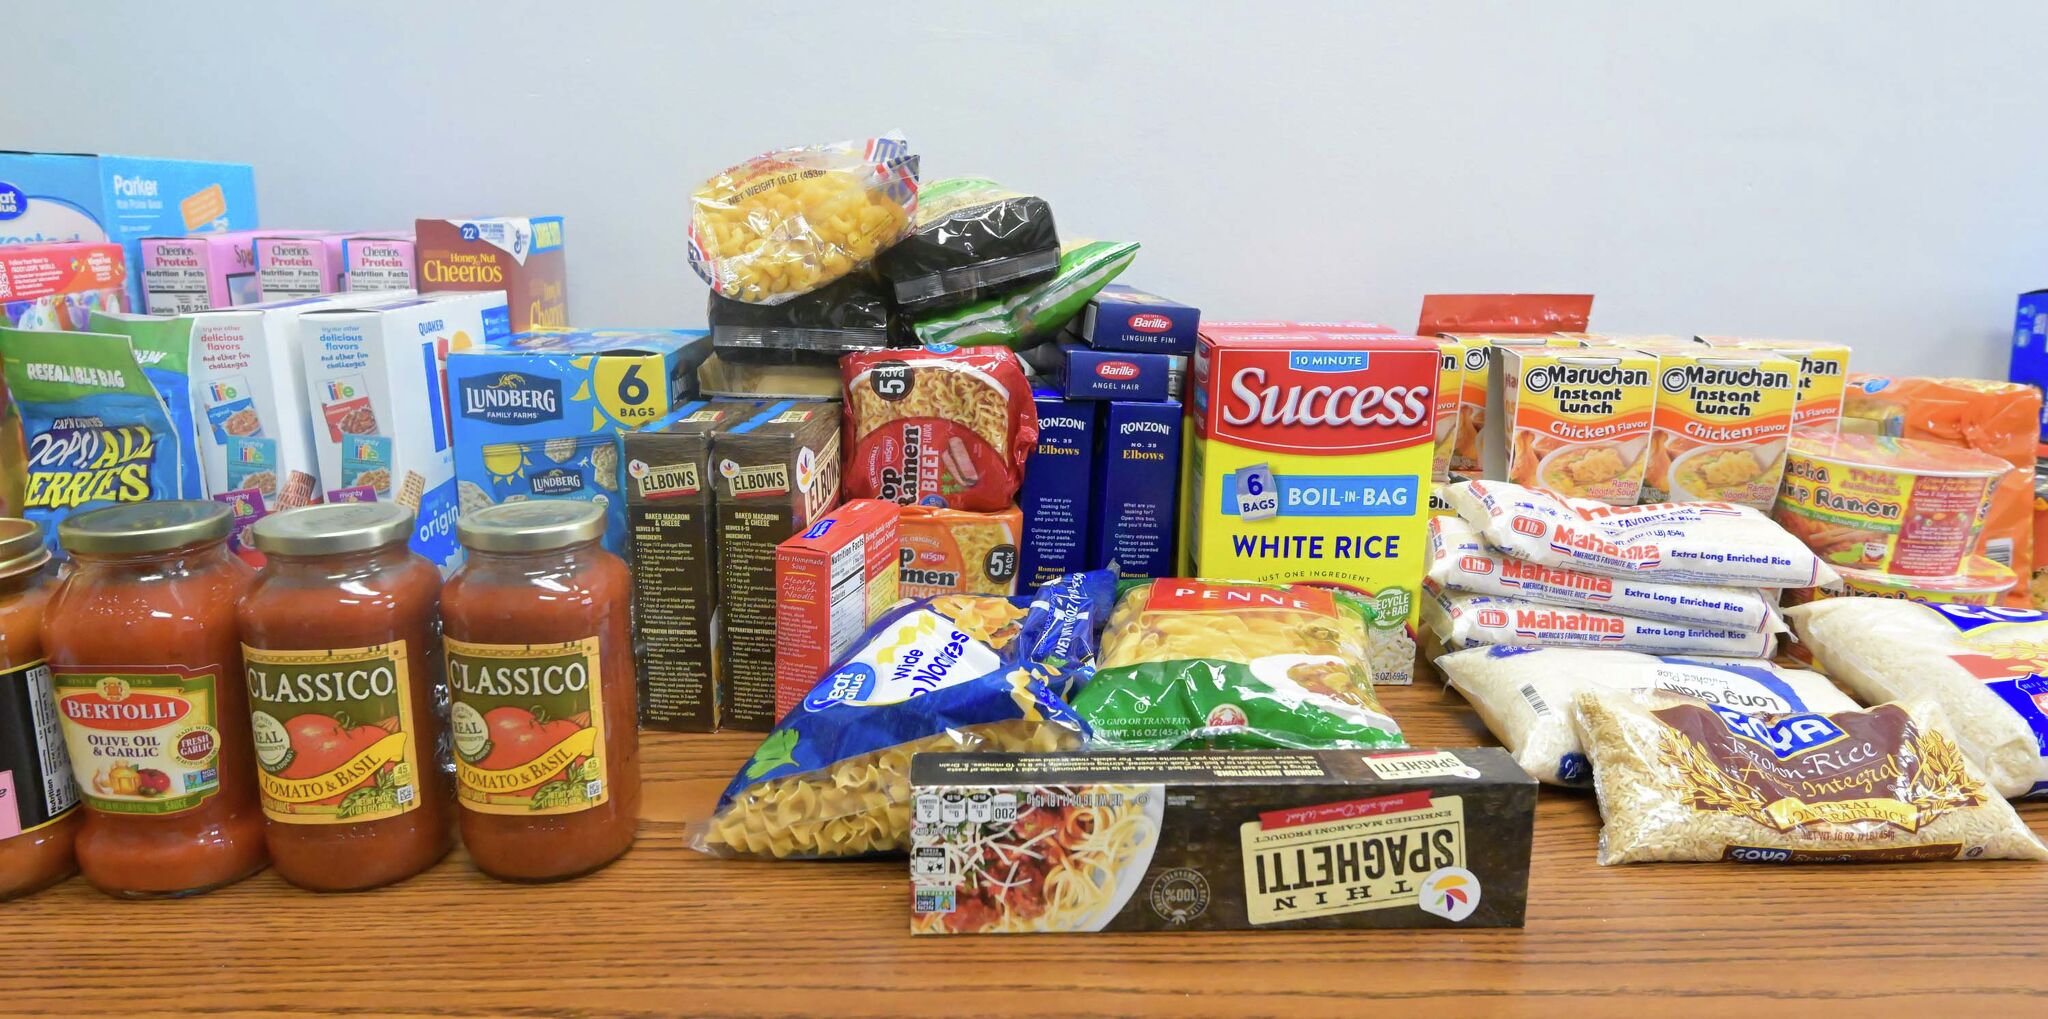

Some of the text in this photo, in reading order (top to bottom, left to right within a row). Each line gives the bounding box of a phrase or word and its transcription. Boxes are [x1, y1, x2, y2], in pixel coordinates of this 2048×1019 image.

[113, 175, 157, 196] Parker
[728, 193, 744, 205] NET
[746, 179, 775, 197] WEIGHT
[777, 176, 787, 187] 16
[788, 173, 798, 184] OZ
[462, 227, 475, 239] 22
[156, 245, 194, 256] Cheerios
[272, 245, 310, 257] Cheerios
[362, 246, 399, 257] Cheerios
[156, 257, 198, 267] Protein
[271, 257, 313, 267] Protein
[361, 258, 403, 267] Protein
[450, 253, 496, 265] Honey Nut
[261, 269, 294, 277] Nutrition
[423, 260, 504, 283] Cheerios
[418, 319, 444, 336] QUAKER
[1133, 317, 1168, 329] Barilla
[201, 334, 244, 343] delicious
[319, 333, 363, 342] delicious
[1121, 334, 1176, 344] LINGUINE FINI
[206, 342, 241, 351] flavors
[325, 342, 359, 351] flavors
[208, 361, 248, 371] challenges
[326, 361, 366, 370] challenges
[1295, 356, 1362, 366] 10 MINUTE
[27, 363, 125, 388] RESEALABLE BAG
[879, 368, 905, 377] PACK
[1100, 364, 1135, 377] Barilla
[1548, 366, 1648, 386] Maruchan
[1685, 366, 1788, 388] Maruchan
[618, 364, 649, 406] 6
[879, 379, 905, 395] 5
[1092, 382, 1140, 391] ANGEL HAIR
[466, 387, 556, 413] LUNDBERG
[1223, 367, 1429, 427] Success
[1553, 386, 1622, 400] Instant
[1690, 387, 1760, 403] Instant
[620, 408, 655, 417] BAGS
[1560, 400, 1613, 414] Lunch
[1696, 401, 1751, 416] Lunch
[1806, 408, 1836, 417] Flavor
[487, 411, 511, 419] FAMILY
[1038, 417, 1085, 431] RONZONI
[1120, 422, 1169, 435] RONZONI
[1550, 420, 1648, 438] Chicken Flavor
[1684, 422, 1786, 441] Chicken Flavor
[90, 426, 155, 469] ALL
[1038, 445, 1080, 455] Elbows
[1123, 449, 1164, 460] Elbows
[922, 424, 939, 492] BEEF FLAVOR
[24, 464, 150, 508] ERRIES
[533, 474, 580, 492] LUNDBERG
[643, 471, 696, 491] ELBOWS
[734, 471, 785, 490] ELBOWS
[1247, 473, 1263, 496] 6
[1611, 480, 1638, 488] Ramen
[1617, 488, 1636, 497] Soup
[1243, 499, 1275, 513] BAGS
[1815, 489, 1898, 517] Ramen
[420, 505, 459, 542] origin
[1232, 534, 1400, 559] WHITE RICE
[1553, 525, 1660, 560] Mahama
[920, 552, 946, 562] NISSIN
[990, 552, 1004, 576] 5
[1004, 552, 1015, 575] PACK
[1671, 550, 1791, 566] Extra Long Enriched Rice
[783, 576, 816, 588] Hearty
[1258, 572, 1280, 583] JUST
[1310, 570, 1370, 583] INGREDIENT
[1502, 559, 1613, 593] Mahatma
[783, 583, 817, 593] Chicken
[784, 590, 815, 600] Noodle
[1522, 582, 1576, 597] AMERICA'S FAVORITE
[1175, 587, 1310, 609] PENNE
[1377, 593, 1410, 610] ECYCLE
[1625, 588, 1744, 613] Extra Long Enriched Rice
[1516, 610, 1624, 633] Mahatma
[1636, 627, 1746, 639] Extra Long Enriched Rice
[891, 650, 924, 681] Wide
[248, 667, 393, 702] CLASSICO
[450, 659, 587, 696] CLASSICO
[1663, 683, 1779, 712] Long Grain
[67, 700, 177, 720] BERTOLLI
[1172, 717, 1190, 725] FATS
[88, 735, 160, 746] OLIVE OIL
[181, 735, 209, 747] FRESH
[93, 747, 159, 758] & GARLIC
[180, 743, 212, 756] GARLIC
[461, 749, 573, 789] TOMATO & BASIL
[1374, 757, 1459, 772] SPAGHETTI
[263, 754, 381, 799] TOMATO & BASIL
[1801, 754, 1903, 798] Integral
[1355, 802, 1377, 812] with
[1379, 798, 1404, 808] made
[994, 807, 1015, 819] 200
[1286, 809, 1318, 822] Wheat
[1253, 809, 1452, 844] ENRICHED MACARONI PRODUCT
[1256, 828, 1454, 895] SPAGHETTI
[1731, 849, 1787, 861] GOYA
[1166, 889, 1195, 902] 100%
[1273, 879, 1413, 911] THIN
